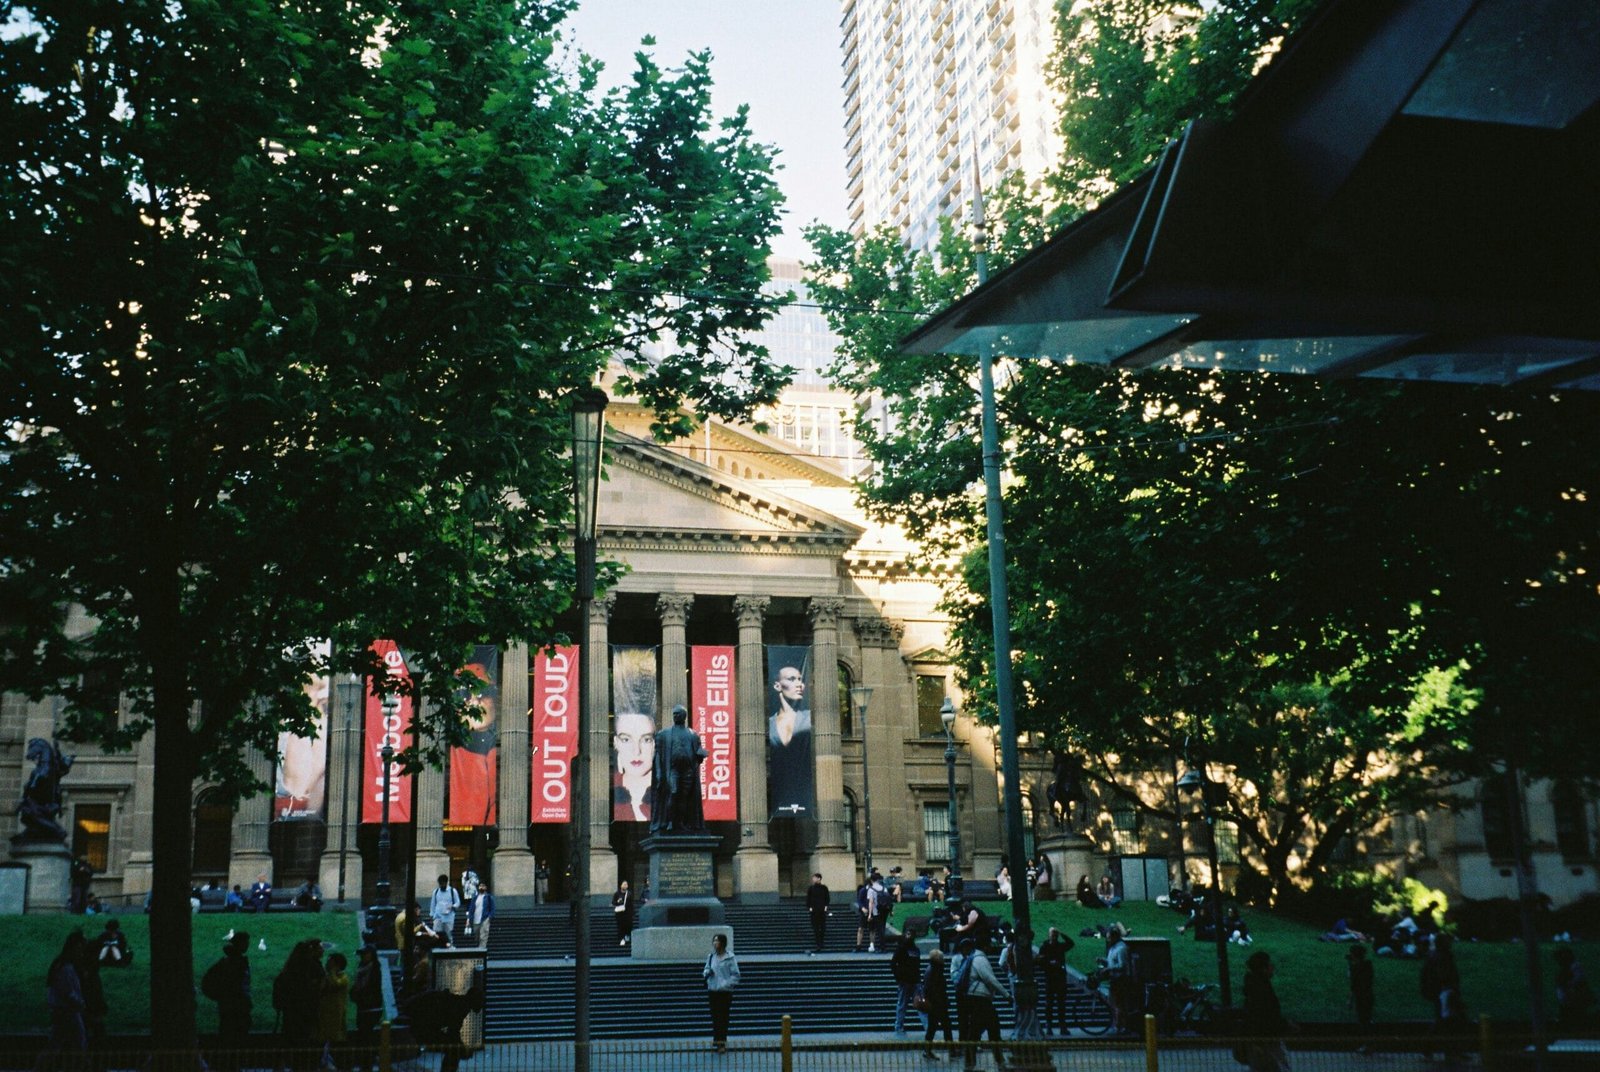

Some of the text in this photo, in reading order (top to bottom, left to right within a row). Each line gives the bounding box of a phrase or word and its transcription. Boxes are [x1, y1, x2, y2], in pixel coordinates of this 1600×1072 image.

[543, 652, 569, 803] OUT LOUD
[698, 706, 705, 716] of
[706, 654, 730, 800] Rennie Ellis
